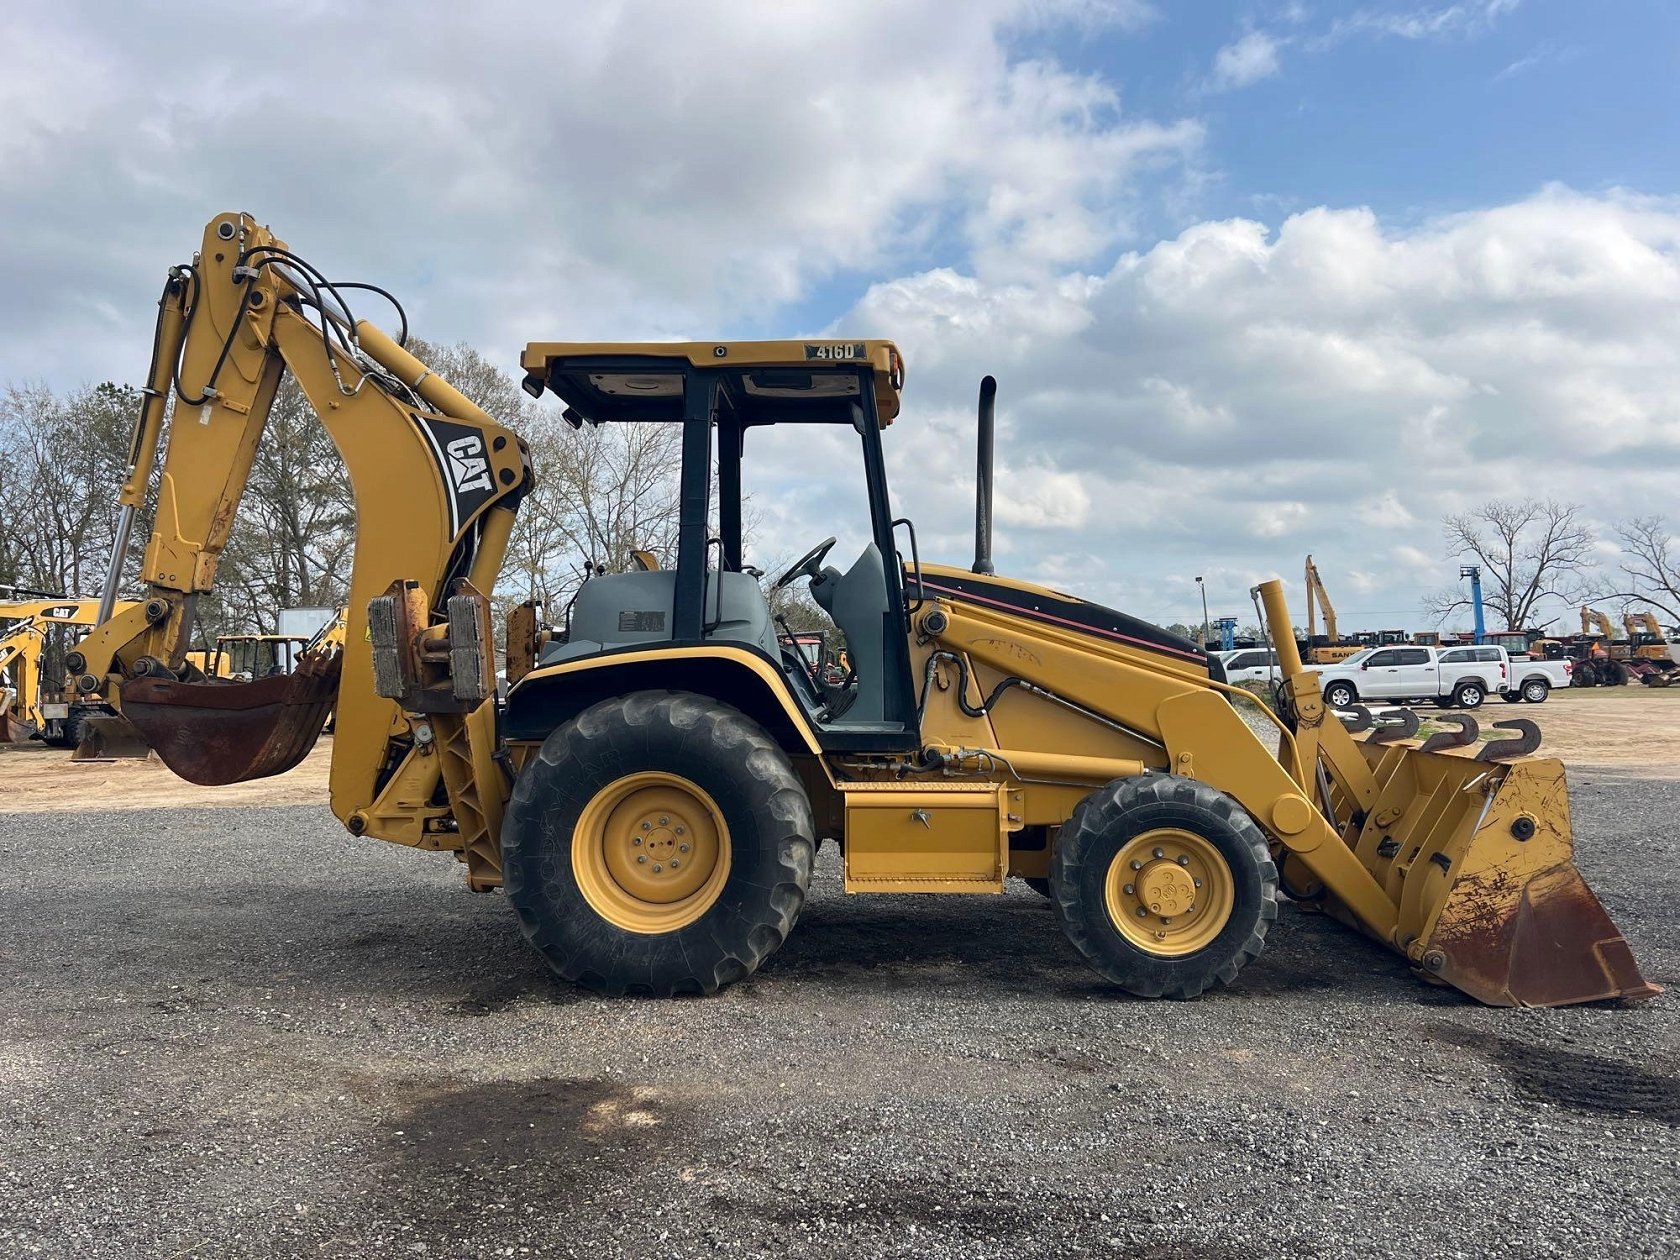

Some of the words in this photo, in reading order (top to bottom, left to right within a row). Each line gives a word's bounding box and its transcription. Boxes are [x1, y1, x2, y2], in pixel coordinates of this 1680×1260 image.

[816, 343, 855, 359] 416D
[447, 435, 493, 493] CAT
[53, 607, 70, 618] CAT
